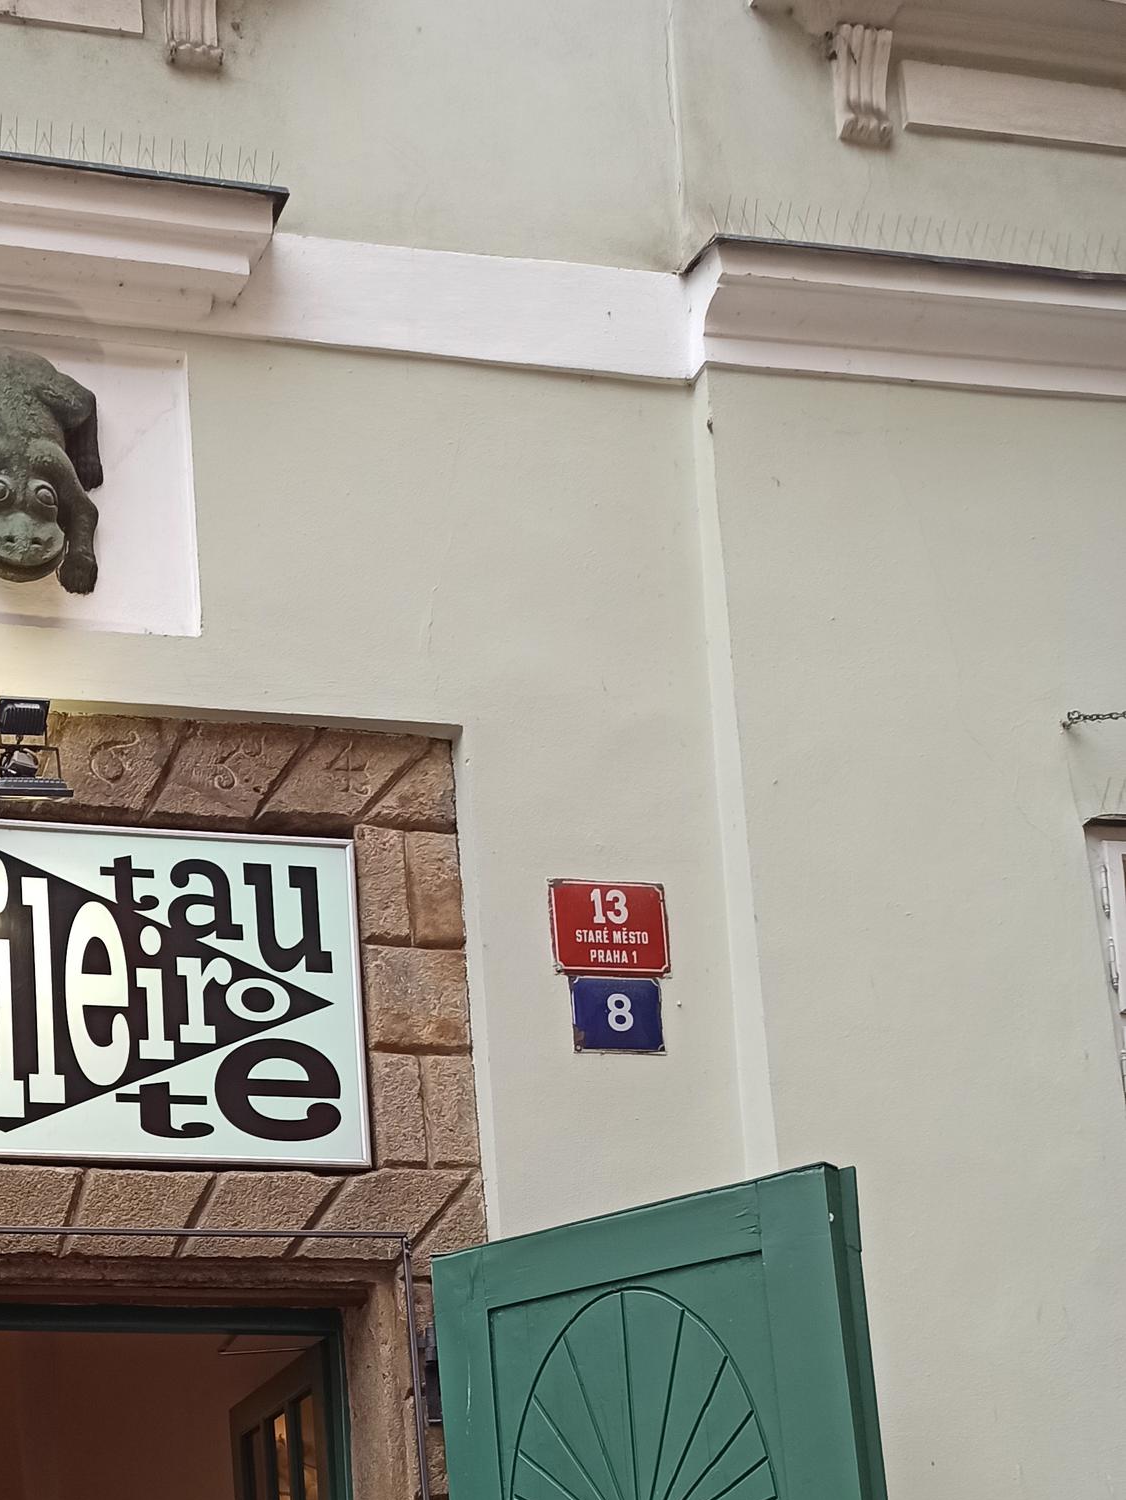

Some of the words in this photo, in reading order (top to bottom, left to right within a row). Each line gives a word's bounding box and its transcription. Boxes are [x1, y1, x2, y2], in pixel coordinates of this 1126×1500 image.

[590, 888, 629, 925] 13
[575, 927, 610, 944] STARÉ
[612, 928, 649, 945] MĚSTO
[589, 949, 629, 964] PRAHA
[631, 951, 638, 964] 1
[606, 993, 634, 1032] 8
